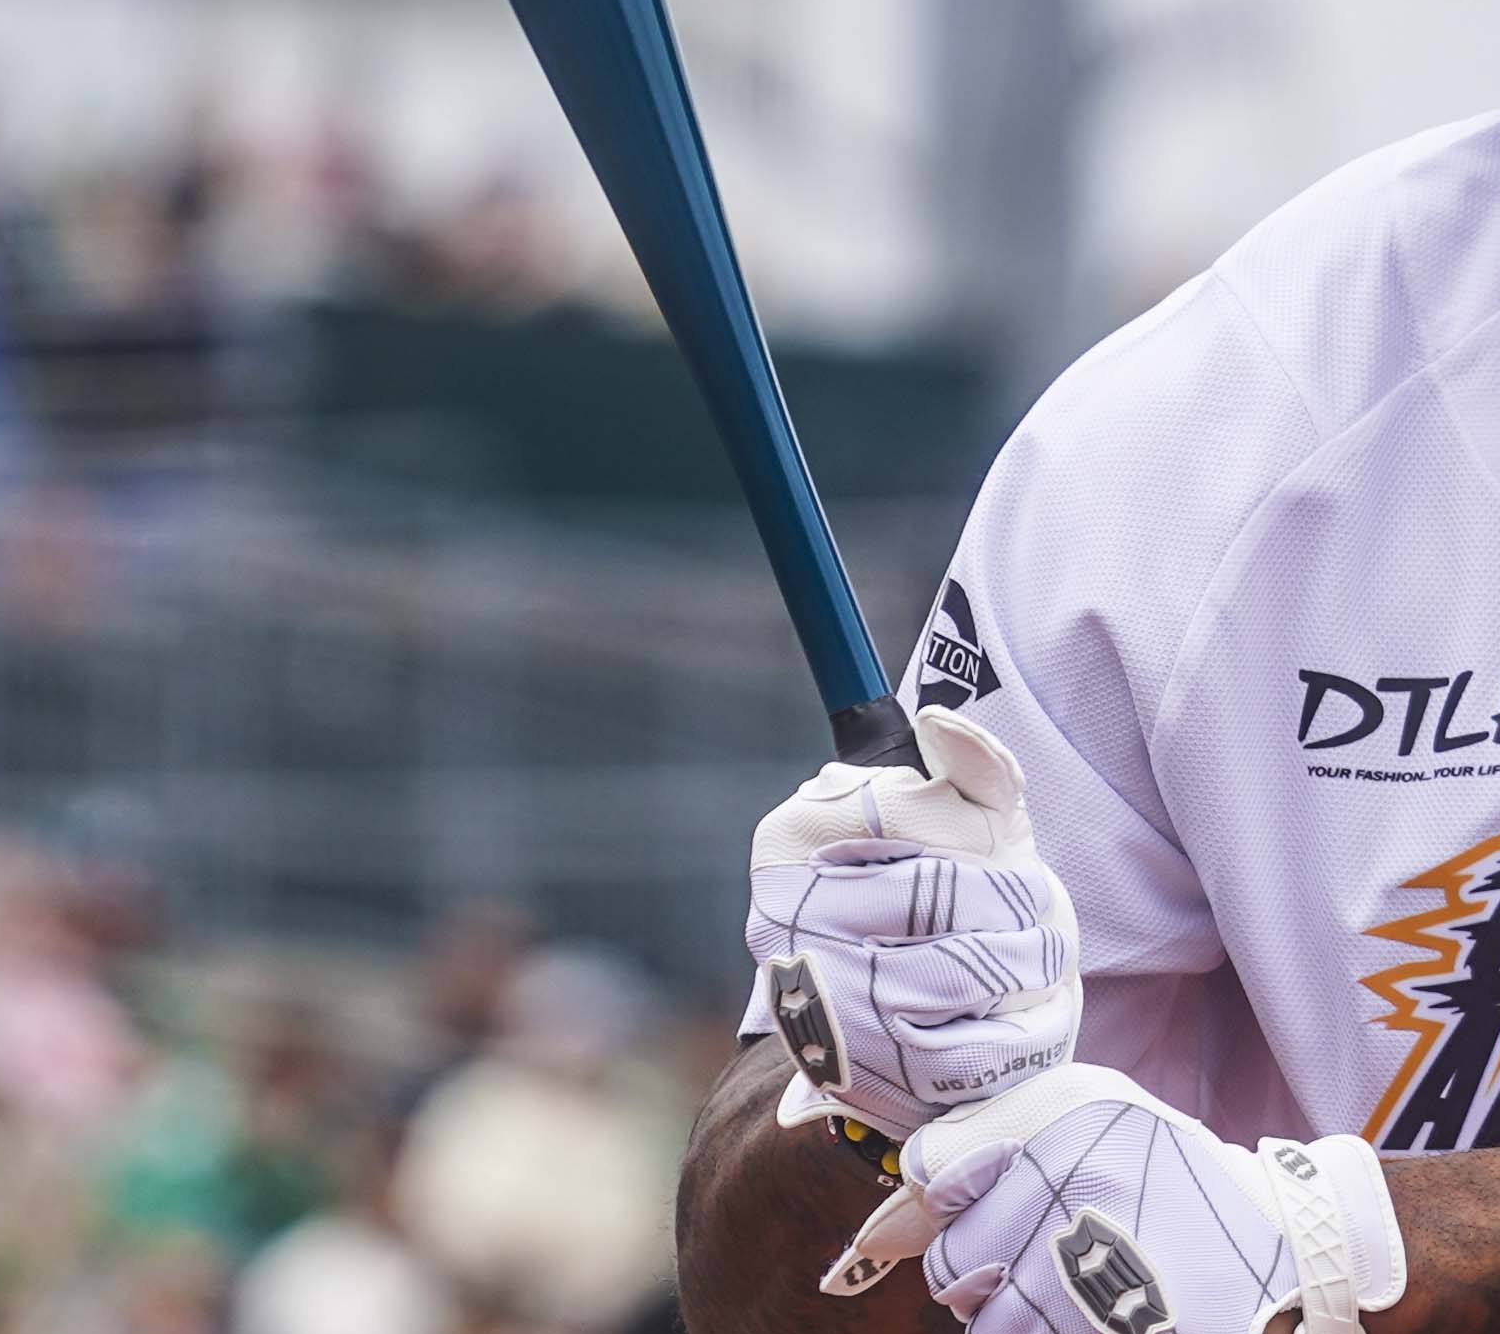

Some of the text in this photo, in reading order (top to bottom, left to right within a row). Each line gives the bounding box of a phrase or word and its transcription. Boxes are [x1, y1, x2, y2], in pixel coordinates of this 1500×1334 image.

[928, 635, 980, 684] TION
[1307, 765, 1351, 781] YOUR
[1433, 766, 1474, 779] YOUR
